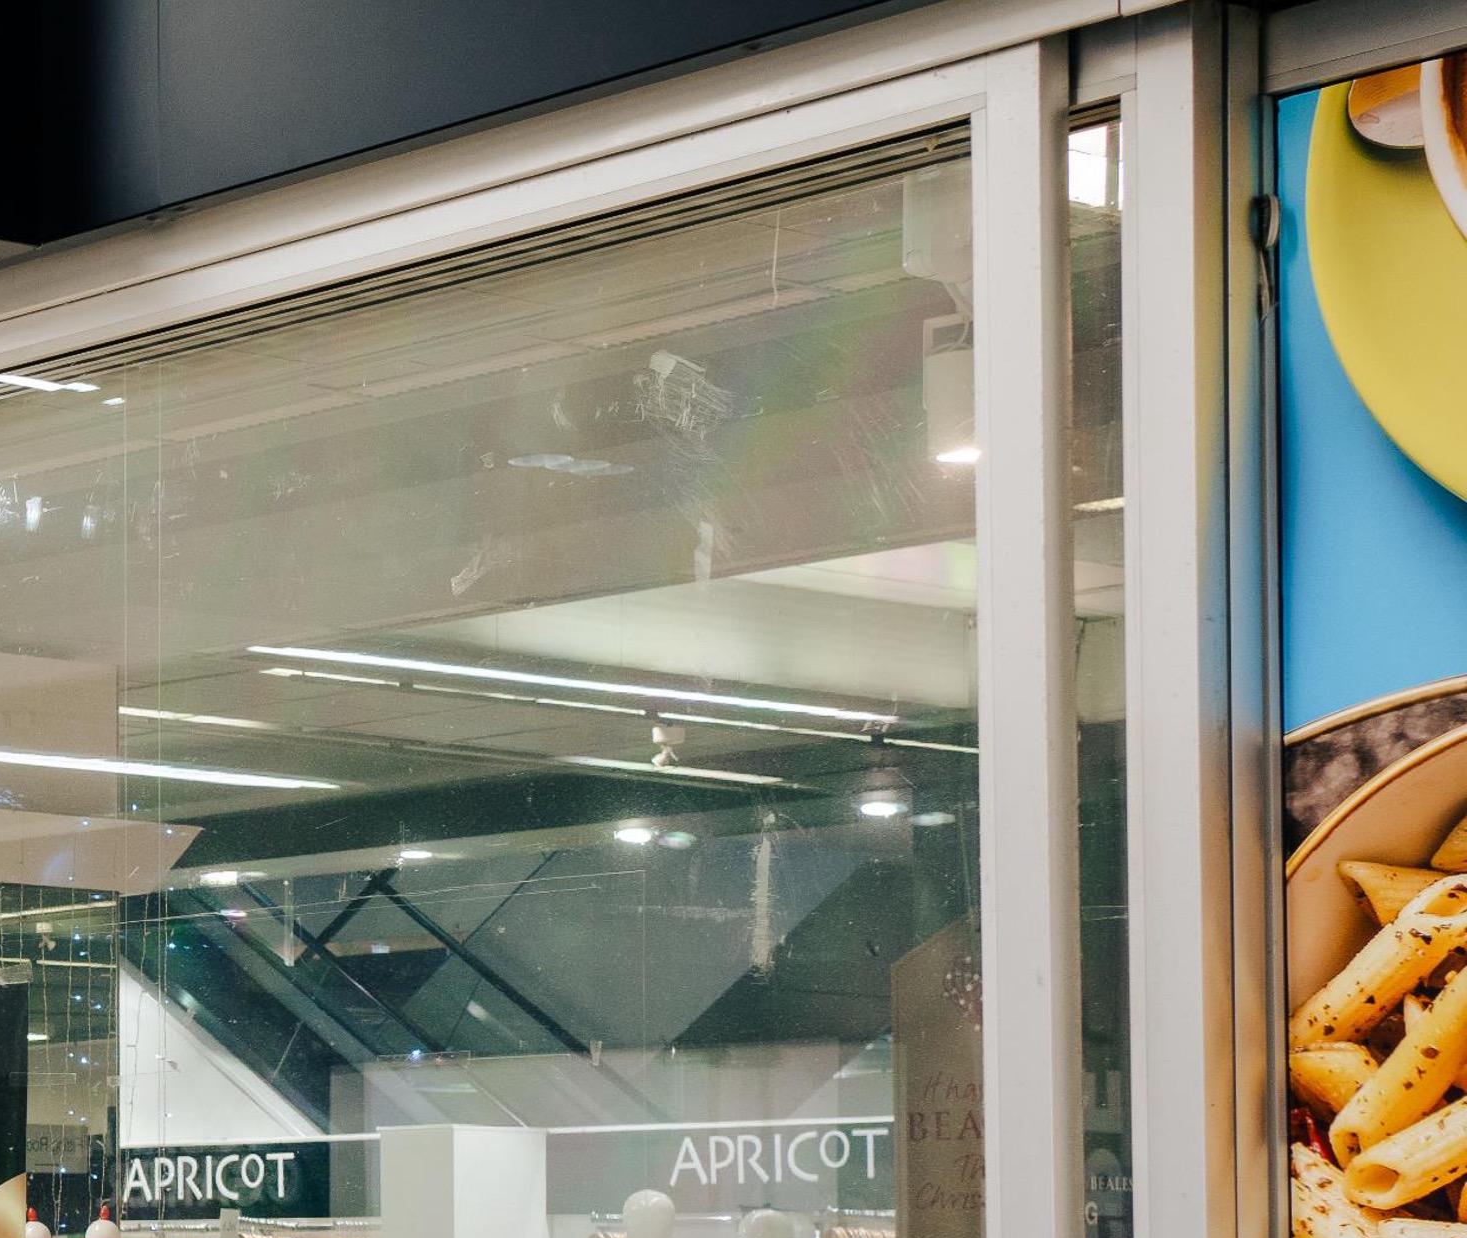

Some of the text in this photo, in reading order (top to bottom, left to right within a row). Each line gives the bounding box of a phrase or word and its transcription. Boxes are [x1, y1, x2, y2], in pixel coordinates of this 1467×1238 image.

[122, 1152, 296, 1203] APRICOT
[669, 1127, 889, 1187] APRICOT
[1085, 1201, 1098, 1225] G
